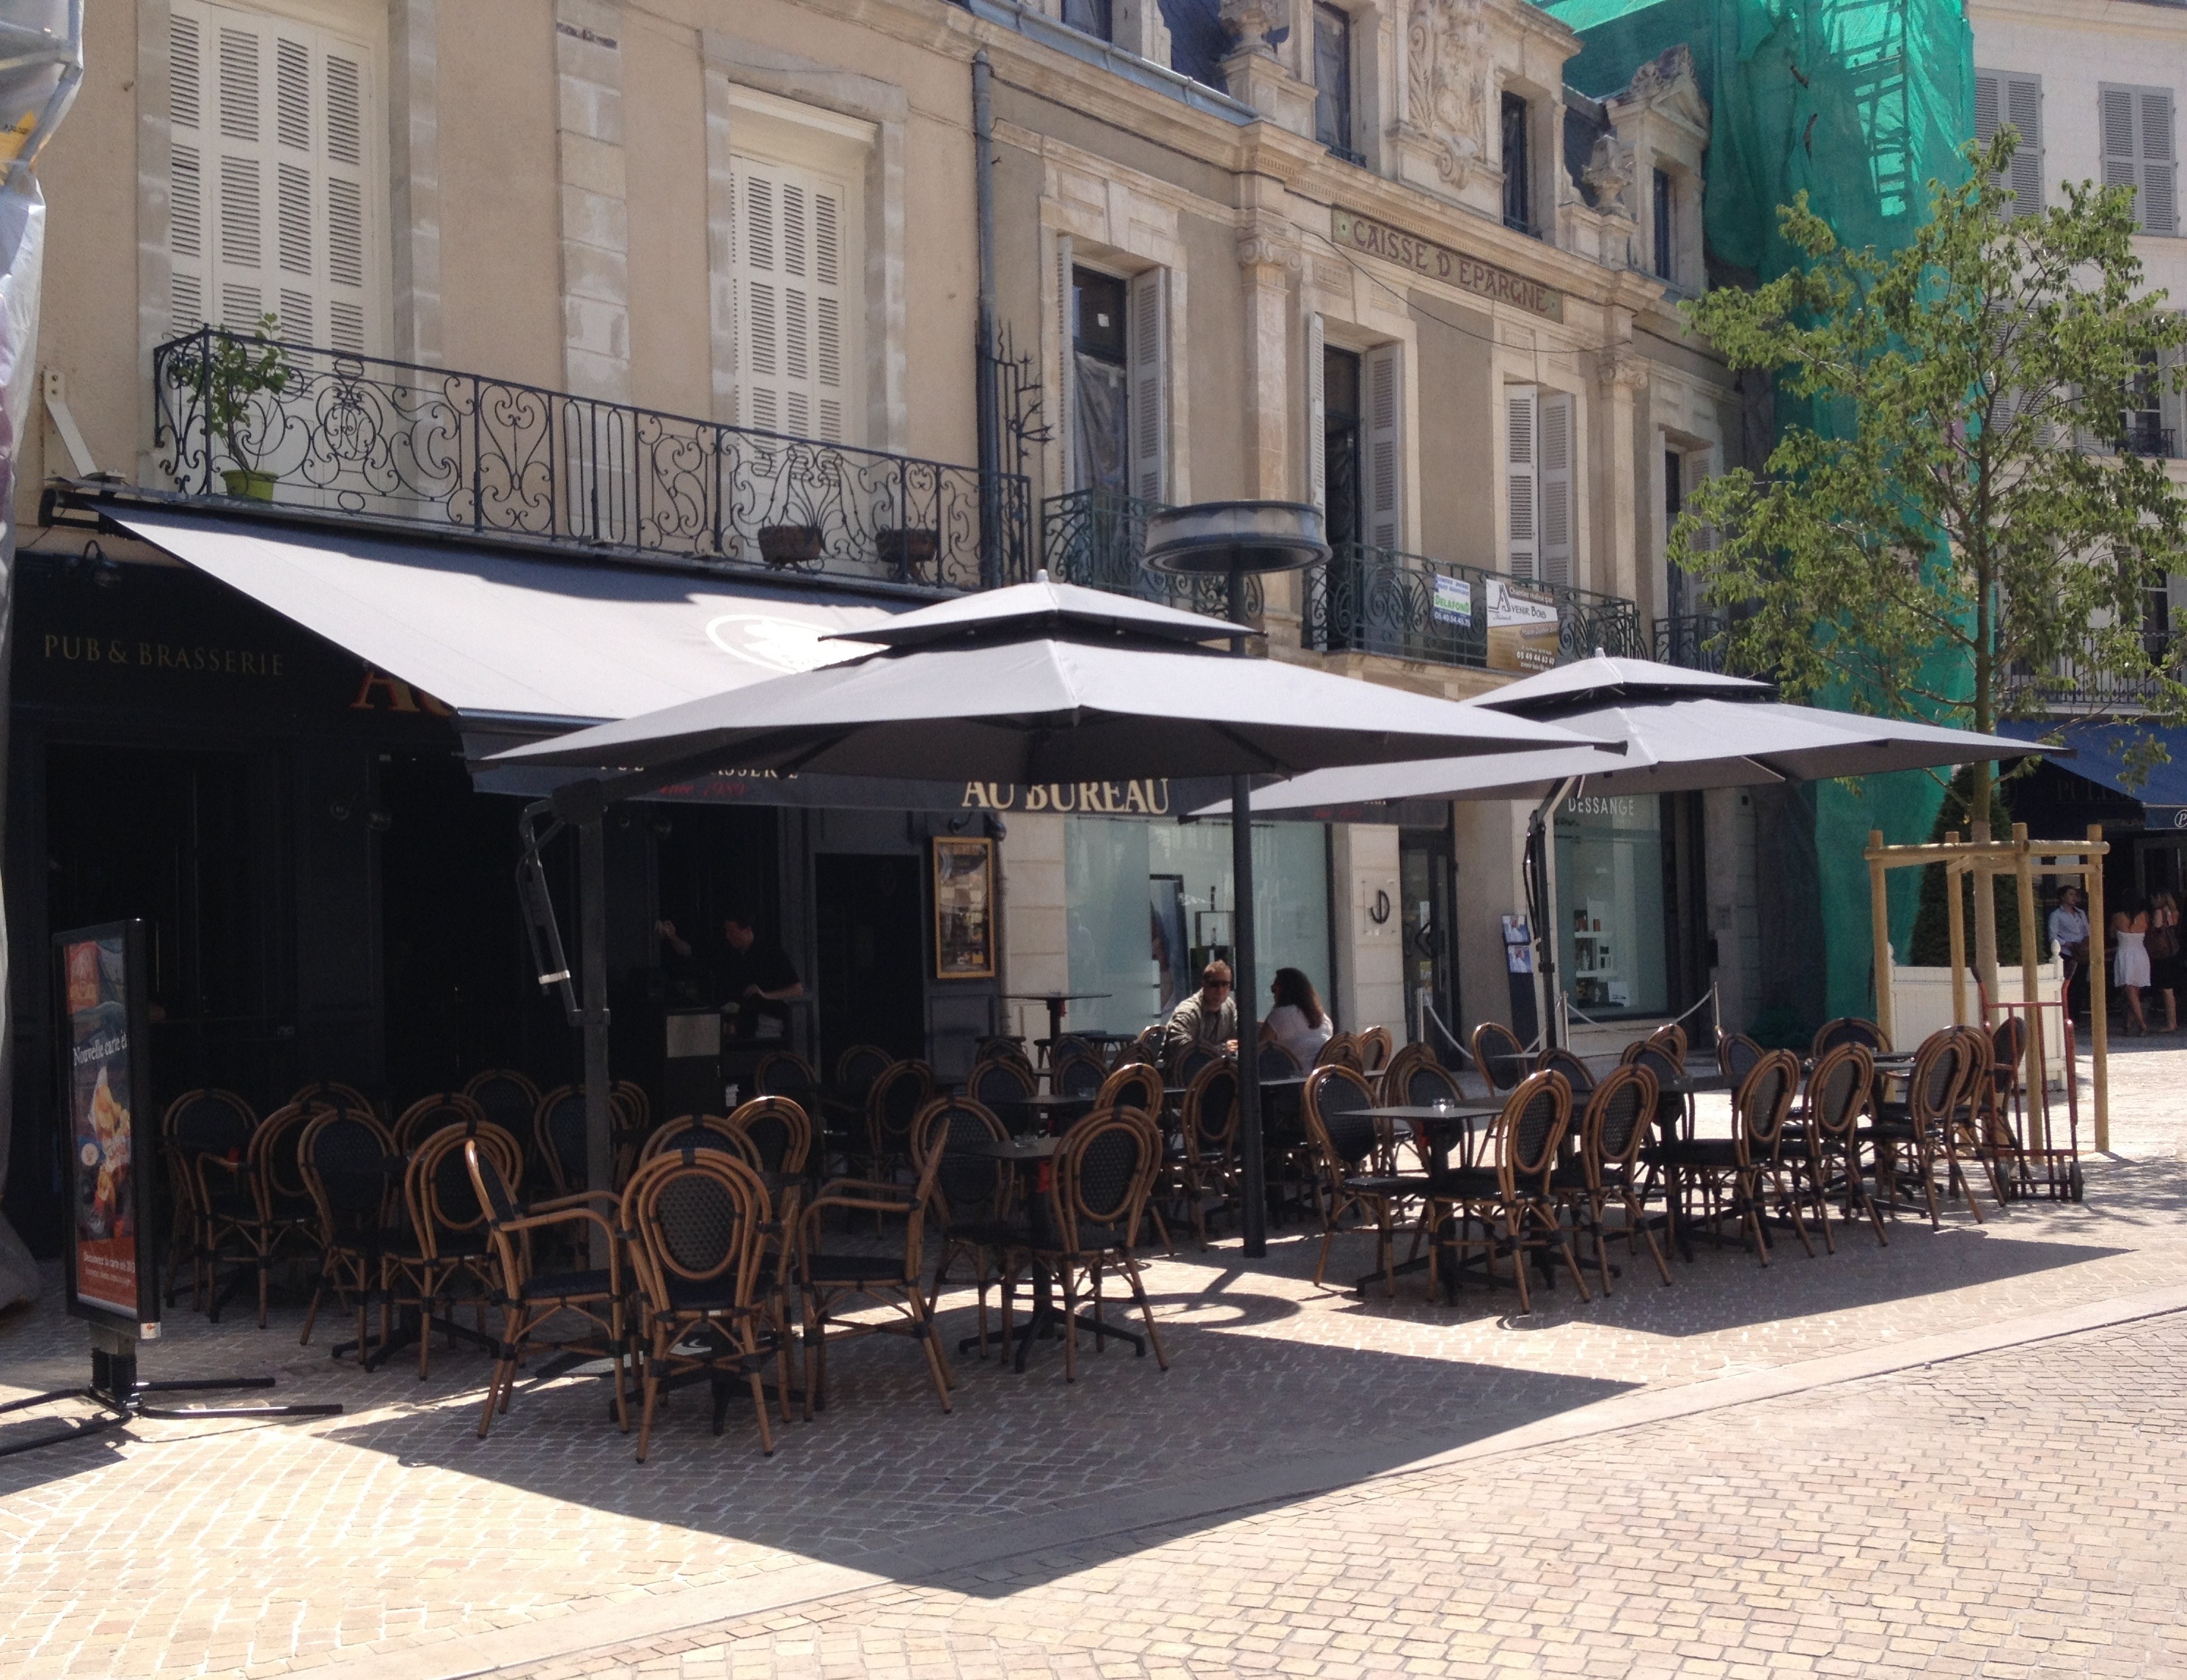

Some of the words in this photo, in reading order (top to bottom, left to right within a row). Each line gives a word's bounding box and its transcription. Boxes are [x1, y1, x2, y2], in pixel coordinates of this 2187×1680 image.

[1353, 220, 1428, 270] CAISSE
[44, 634, 100, 661] PUB
[109, 642, 128, 664] &
[139, 642, 284, 676] BRASSERIE
[961, 780, 1015, 810] AU
[1025, 777, 1169, 815] BUREAU
[1568, 797, 1635, 816] DESSANGE
[73, 1038, 104, 1067] Nouvelle
[104, 1037, 120, 1056] carte
